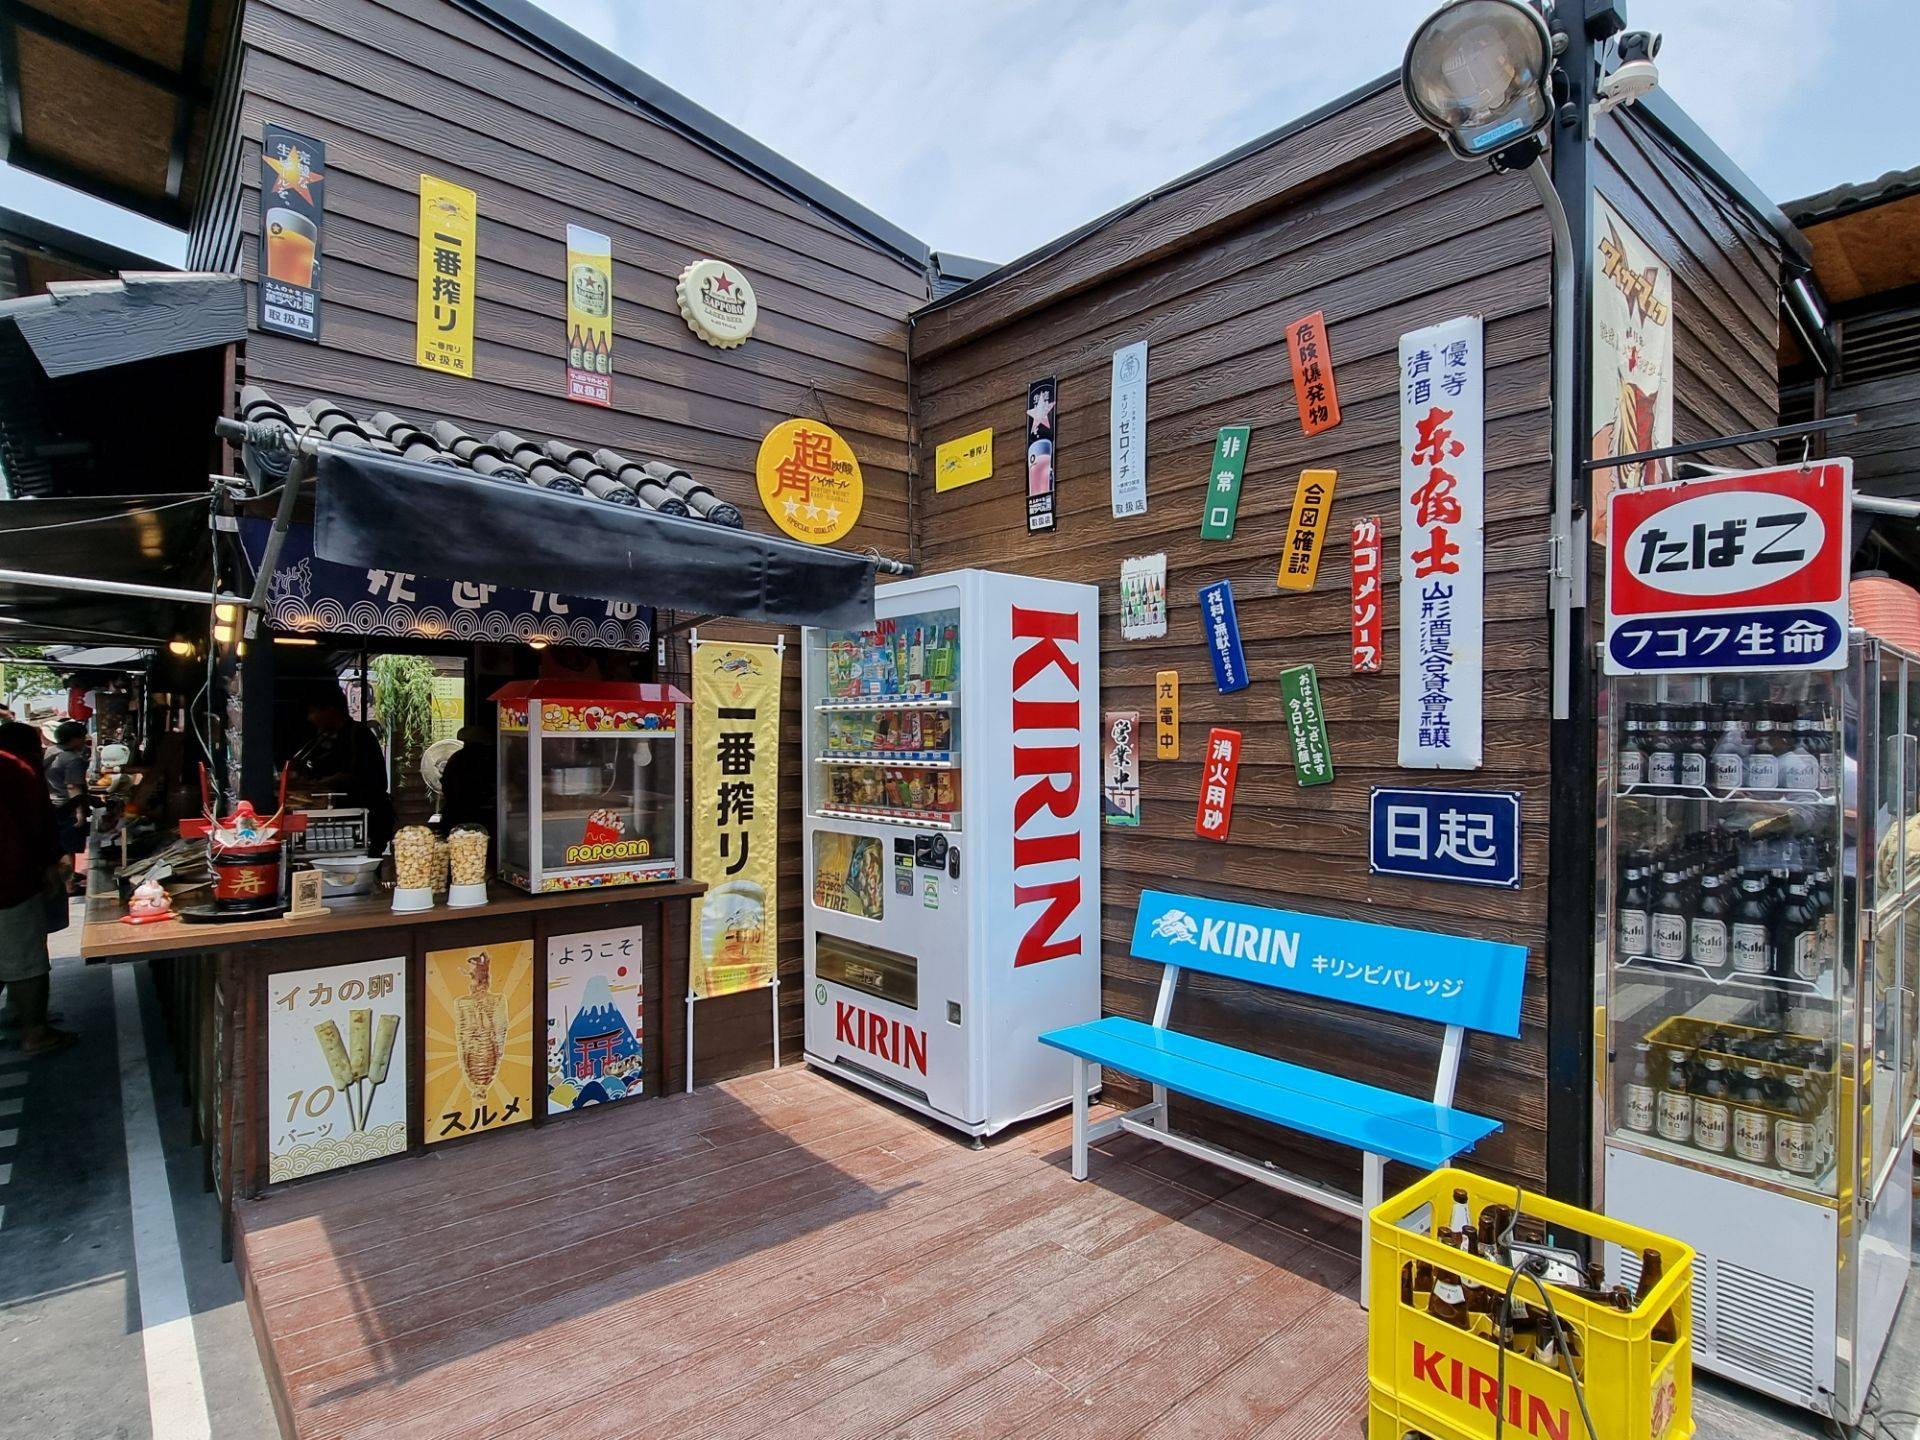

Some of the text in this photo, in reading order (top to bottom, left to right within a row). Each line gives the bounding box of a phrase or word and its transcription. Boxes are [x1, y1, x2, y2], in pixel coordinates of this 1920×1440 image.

[433, 232, 463, 331] 一番搾り
[268, 308, 312, 329] 取扱店
[703, 294, 744, 315] SAPPORO
[1407, 350, 1432, 405] 清酒
[1440, 340, 1470, 397] 優等
[810, 475, 850, 489] ハイボール
[1210, 437, 1241, 527] 非常口
[1288, 483, 1325, 575] 合図確認
[1638, 512, 1807, 575] たばこ
[1352, 521, 1377, 672] カゴメソース
[1621, 619, 1827, 658] フコク生命
[1159, 681, 1174, 749] 充電中
[717, 707, 757, 877] 一番搾り
[1012, 603, 1082, 968] KIRIN
[568, 841, 650, 863] POPCORN
[1387, 805, 1497, 867] 日起
[228, 869, 266, 895] 寿
[558, 938, 635, 965] ようこそ
[1199, 917, 1300, 969] KIRIN
[1653, 929, 1682, 942] Asahi
[1692, 934, 1723, 948] Asahi
[1734, 940, 1766, 953] Asahi
[276, 973, 394, 1011] イカの卵
[1312, 955, 1465, 999] キリンビバレッジ
[836, 1000, 928, 1078] KIRIN
[286, 1085, 336, 1123] 10
[440, 1096, 521, 1137] スルメ
[1695, 1115, 1724, 1131] Asahi
[1413, 1339, 1570, 1440] KIRIN
